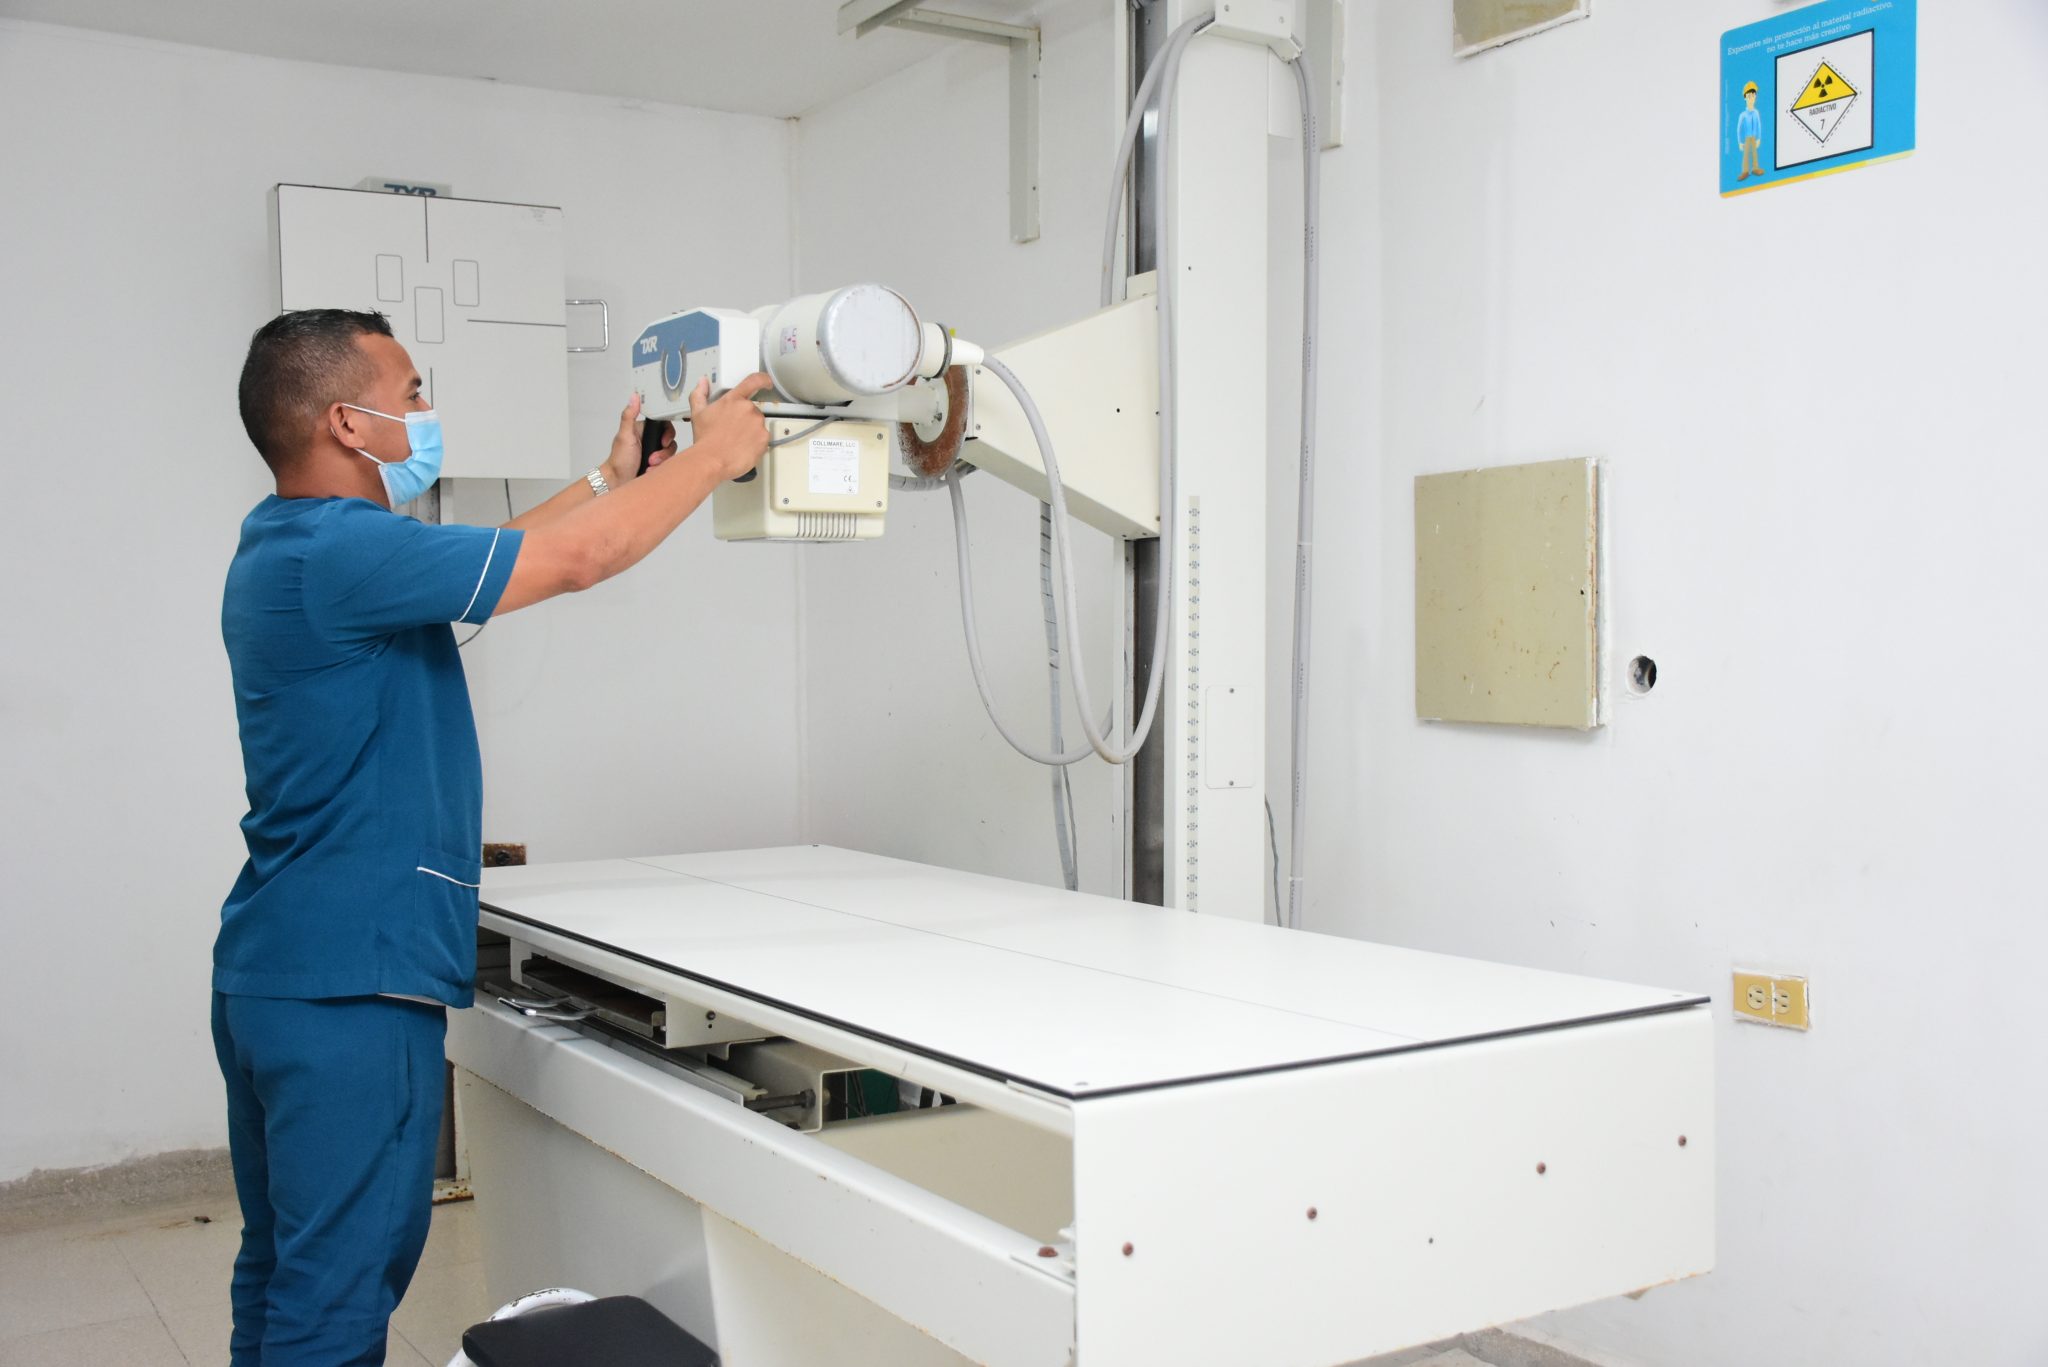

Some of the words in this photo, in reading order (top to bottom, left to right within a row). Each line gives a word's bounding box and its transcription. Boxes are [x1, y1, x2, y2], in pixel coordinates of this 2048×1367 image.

[1728, 40, 1761, 55] Exponerte
[1763, 36, 1773, 45] sin
[1775, 24, 1811, 43] protección
[1813, 21, 1820, 30] al
[1821, 12, 1852, 27] material
[1786, 37, 1803, 48] hace
[1820, 119, 1825, 130] 7
[640, 336, 658, 354] TXR
